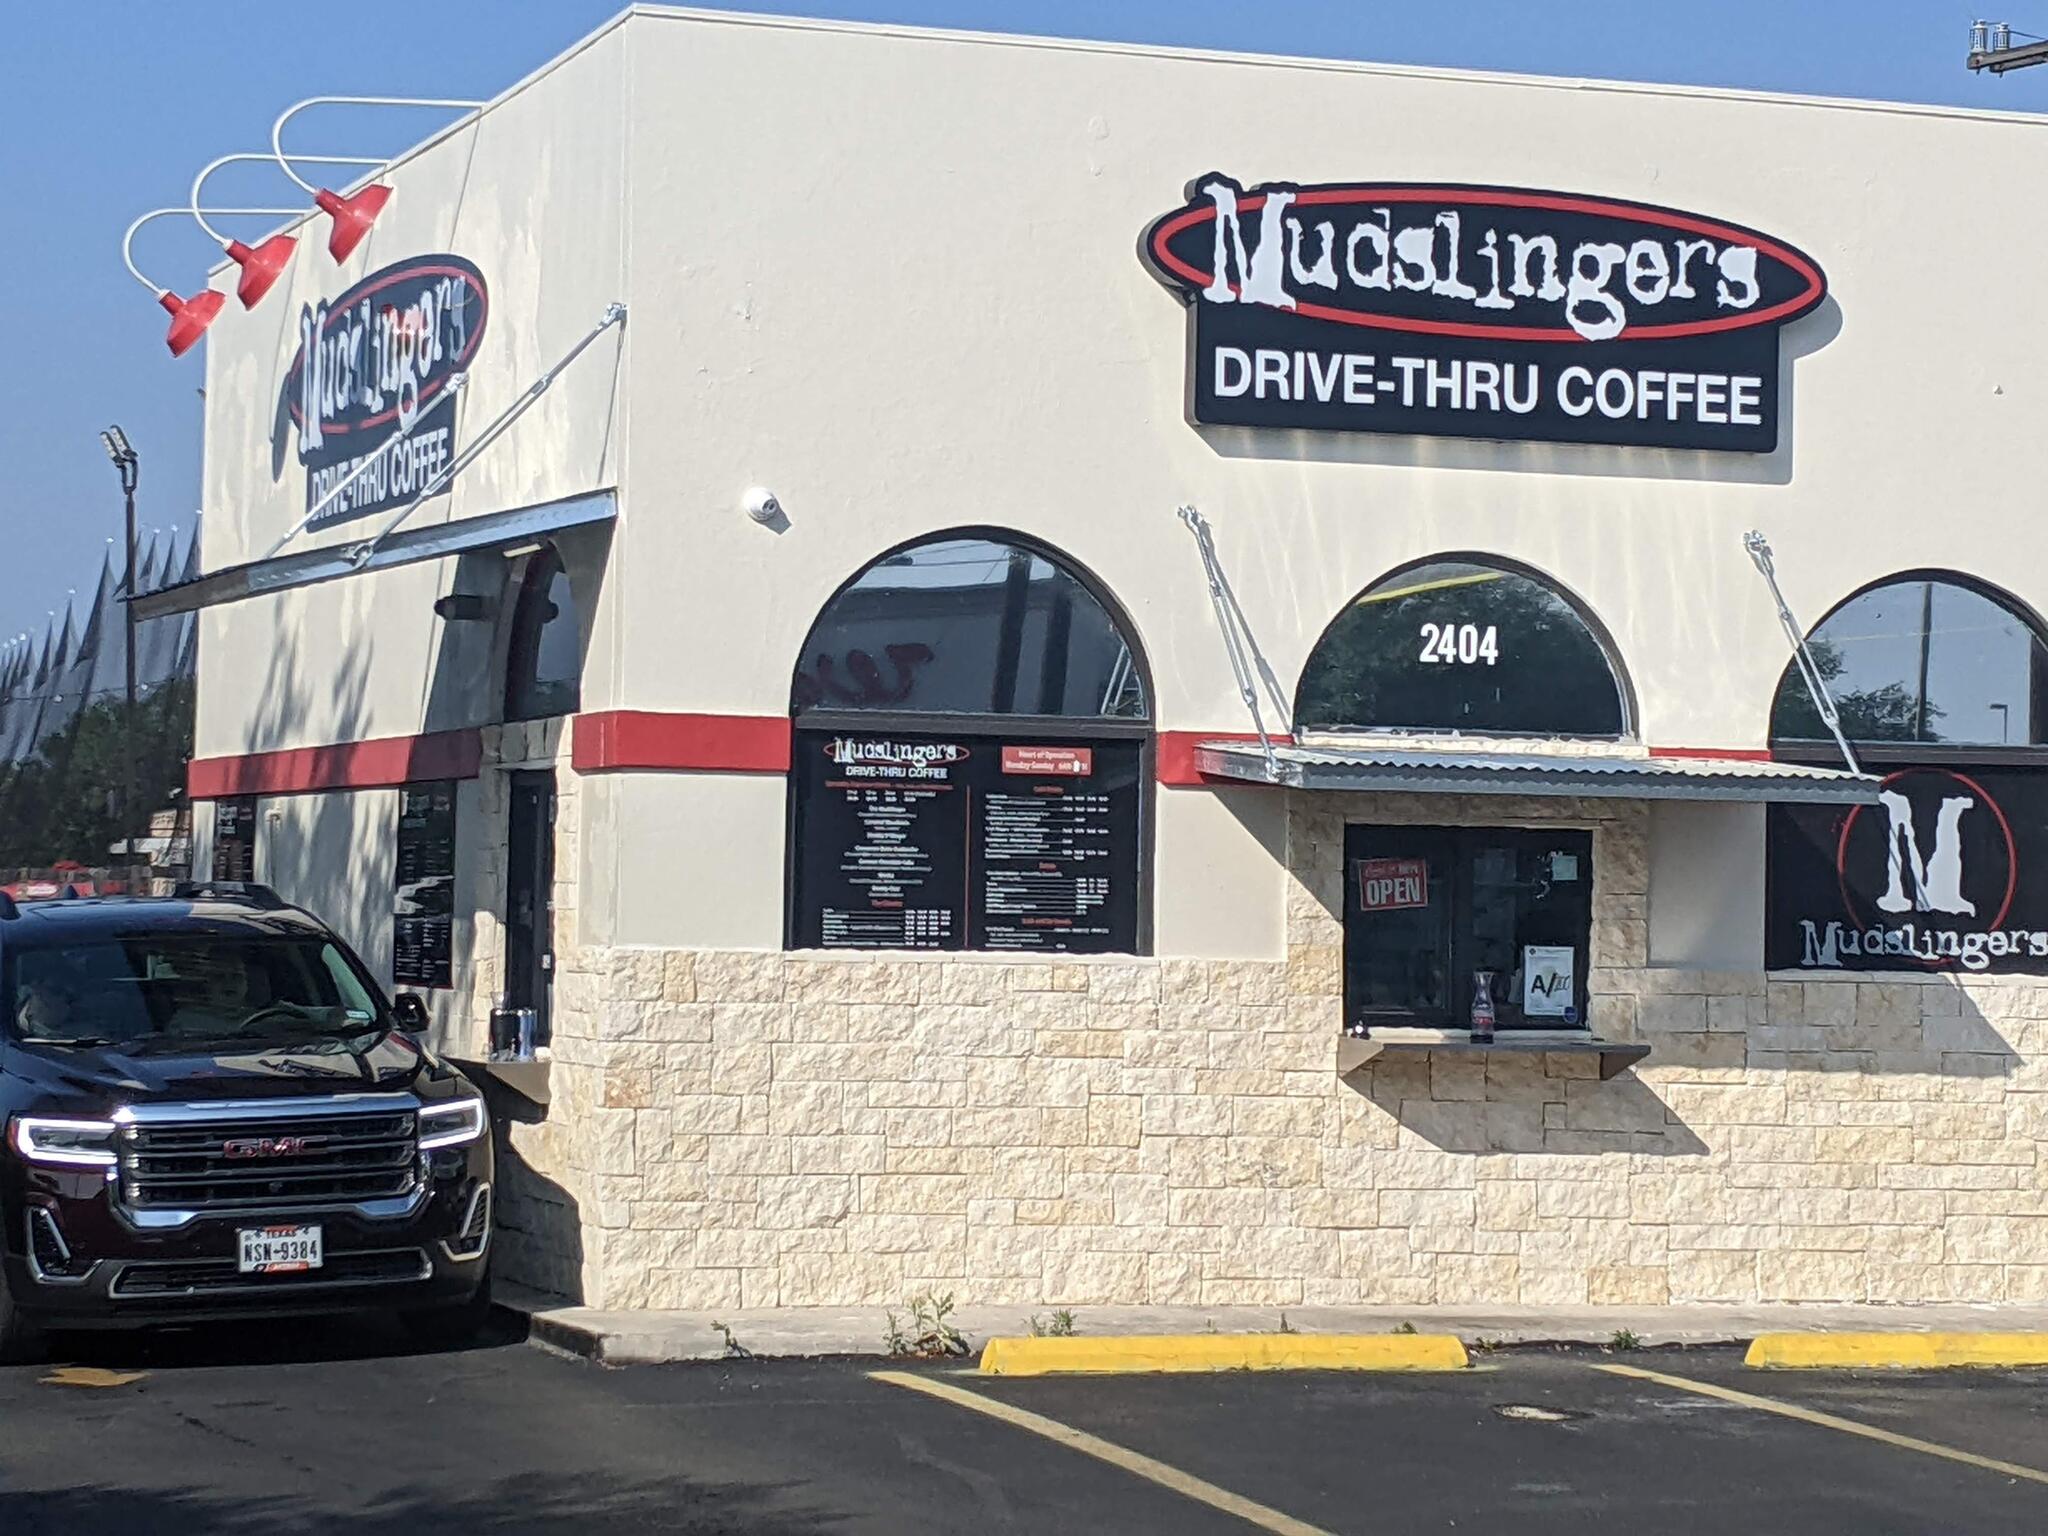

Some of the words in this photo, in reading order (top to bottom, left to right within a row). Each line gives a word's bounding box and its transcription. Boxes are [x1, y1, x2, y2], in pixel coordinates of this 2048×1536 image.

[1203, 182, 1763, 341] Mudslingers
[300, 275, 466, 454] Mudslingers
[1214, 347, 1540, 415] DRIVE-THRU
[1558, 366, 1762, 426] COFFEE
[390, 427, 449, 498] COFFEE
[1418, 622, 1499, 666] 2404
[833, 737, 957, 767] Mudslingers
[846, 766, 906, 777] DRIVE-THRU
[908, 768, 948, 779] COFFEE
[1876, 789, 1976, 918] M
[1366, 876, 1422, 906] OPEN
[1799, 919, 2048, 970] Mudslingers
[224, 1135, 328, 1158] GMC
